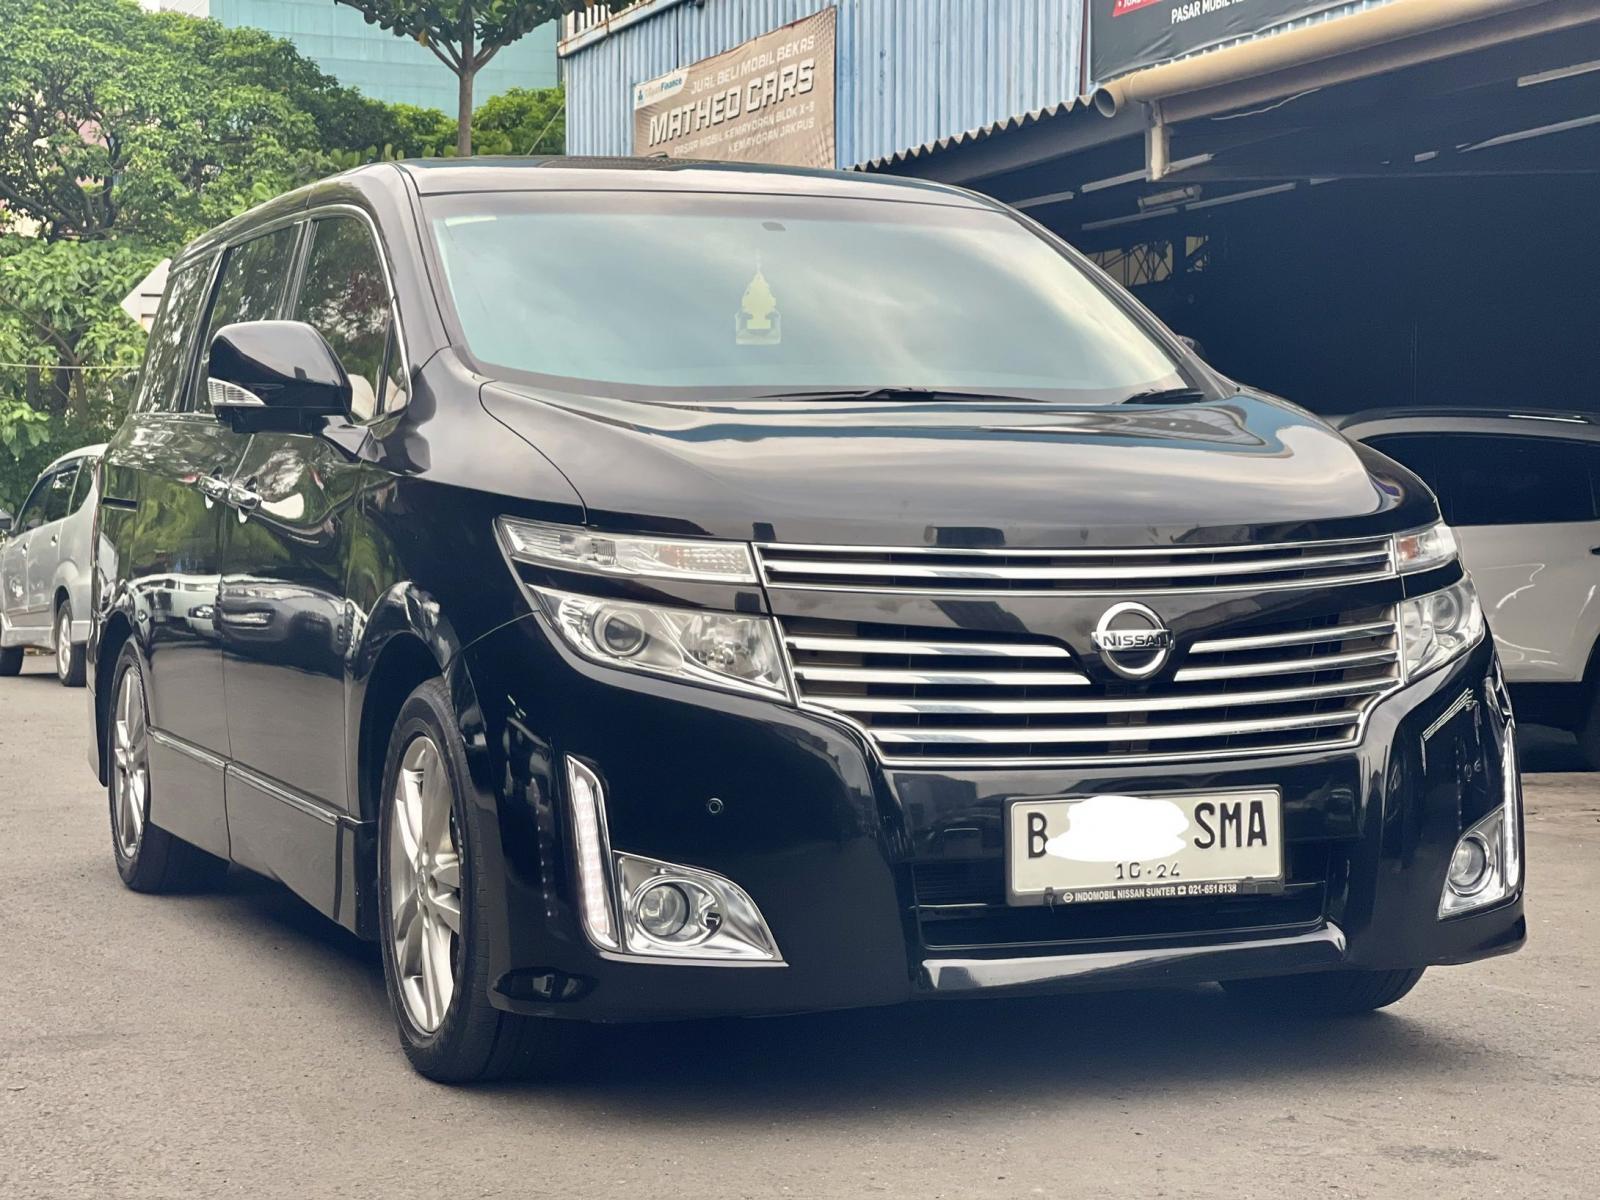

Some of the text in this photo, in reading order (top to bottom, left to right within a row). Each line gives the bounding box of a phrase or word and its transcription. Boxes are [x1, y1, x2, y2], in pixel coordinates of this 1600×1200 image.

[1171, 1, 1201, 24] PASAR
[691, 35, 815, 94] JUAL BELI MOBIL BEKAS
[746, 58, 815, 113] CARS
[1103, 634, 1168, 647] NISSAN
[1027, 800, 1268, 859] B SMA
[1074, 890, 1116, 902] INDOMOBIL
[1117, 889, 1145, 899] NISSAN
[1146, 886, 1176, 897] SUNTER
